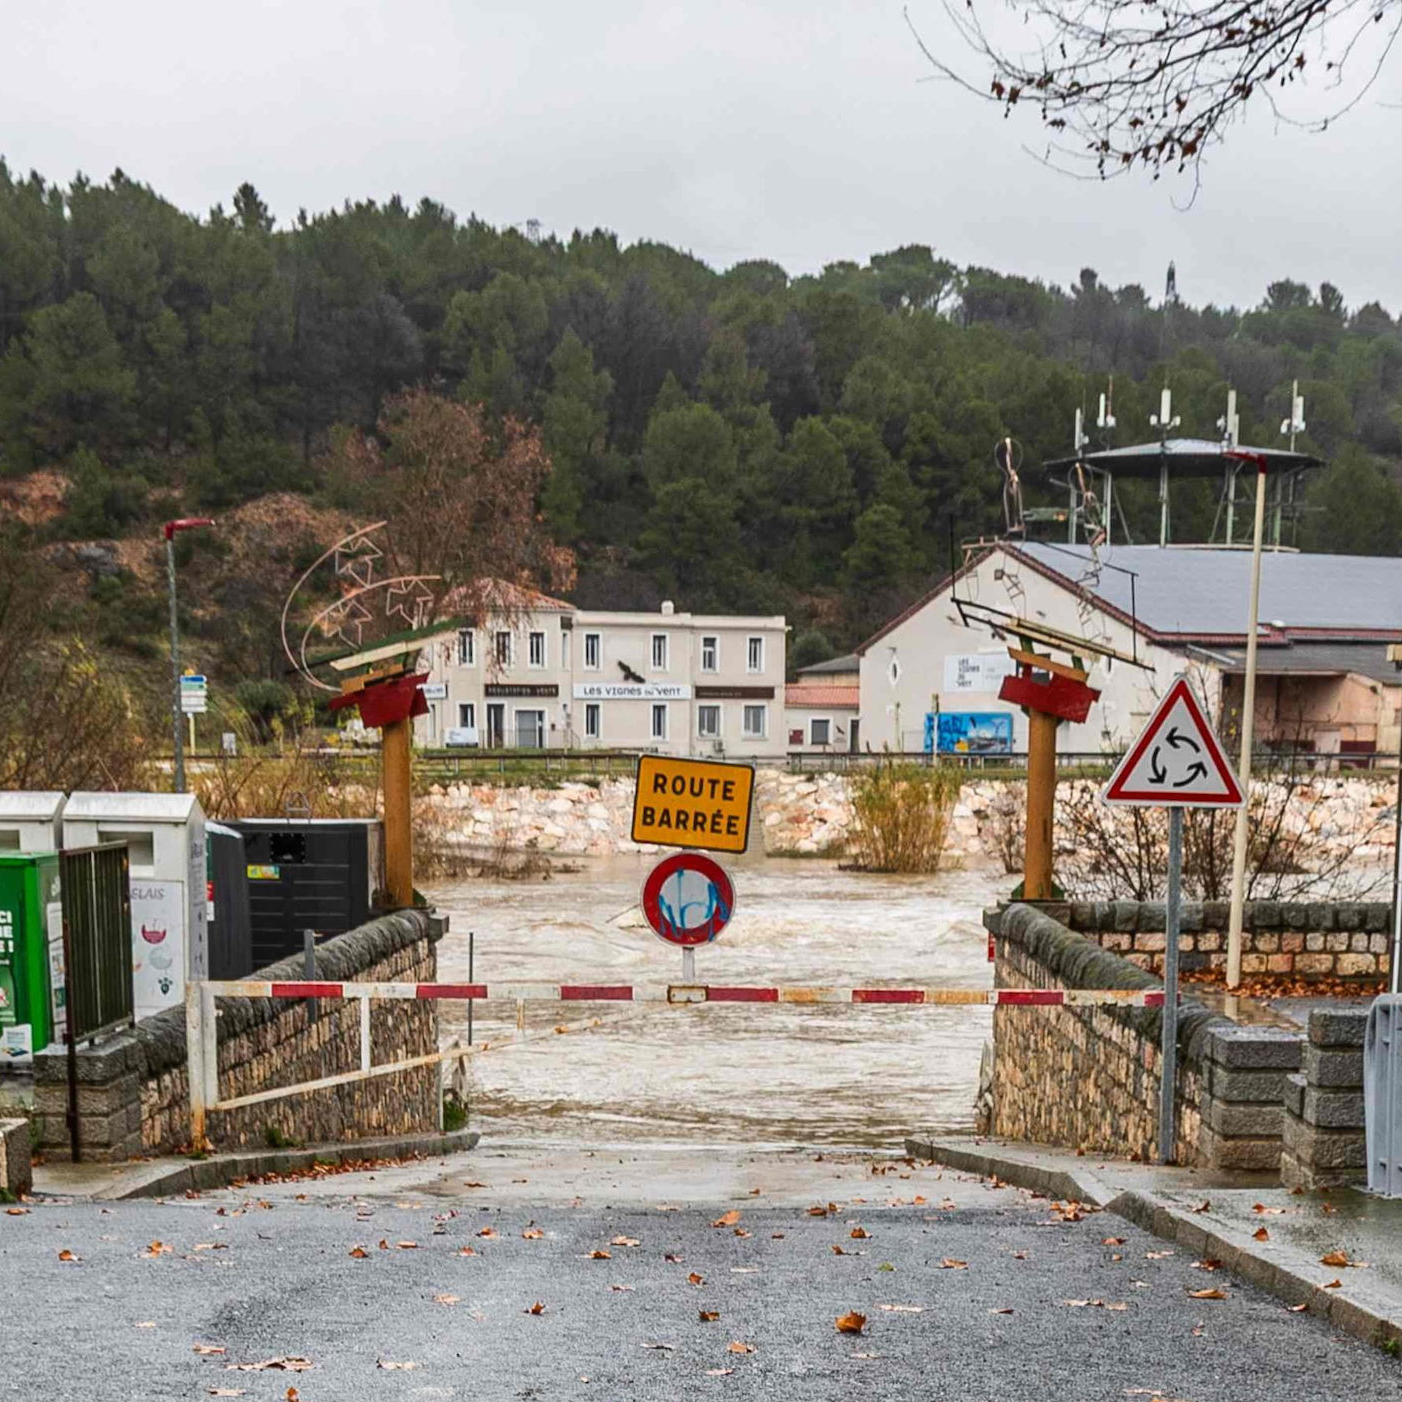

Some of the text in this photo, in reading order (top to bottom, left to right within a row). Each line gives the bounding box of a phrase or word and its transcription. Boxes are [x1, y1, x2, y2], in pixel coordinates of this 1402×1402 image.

[653, 773, 736, 801] ROUTE
[641, 806, 740, 836] BARRÉE
[129, 887, 165, 900] ELAIS
